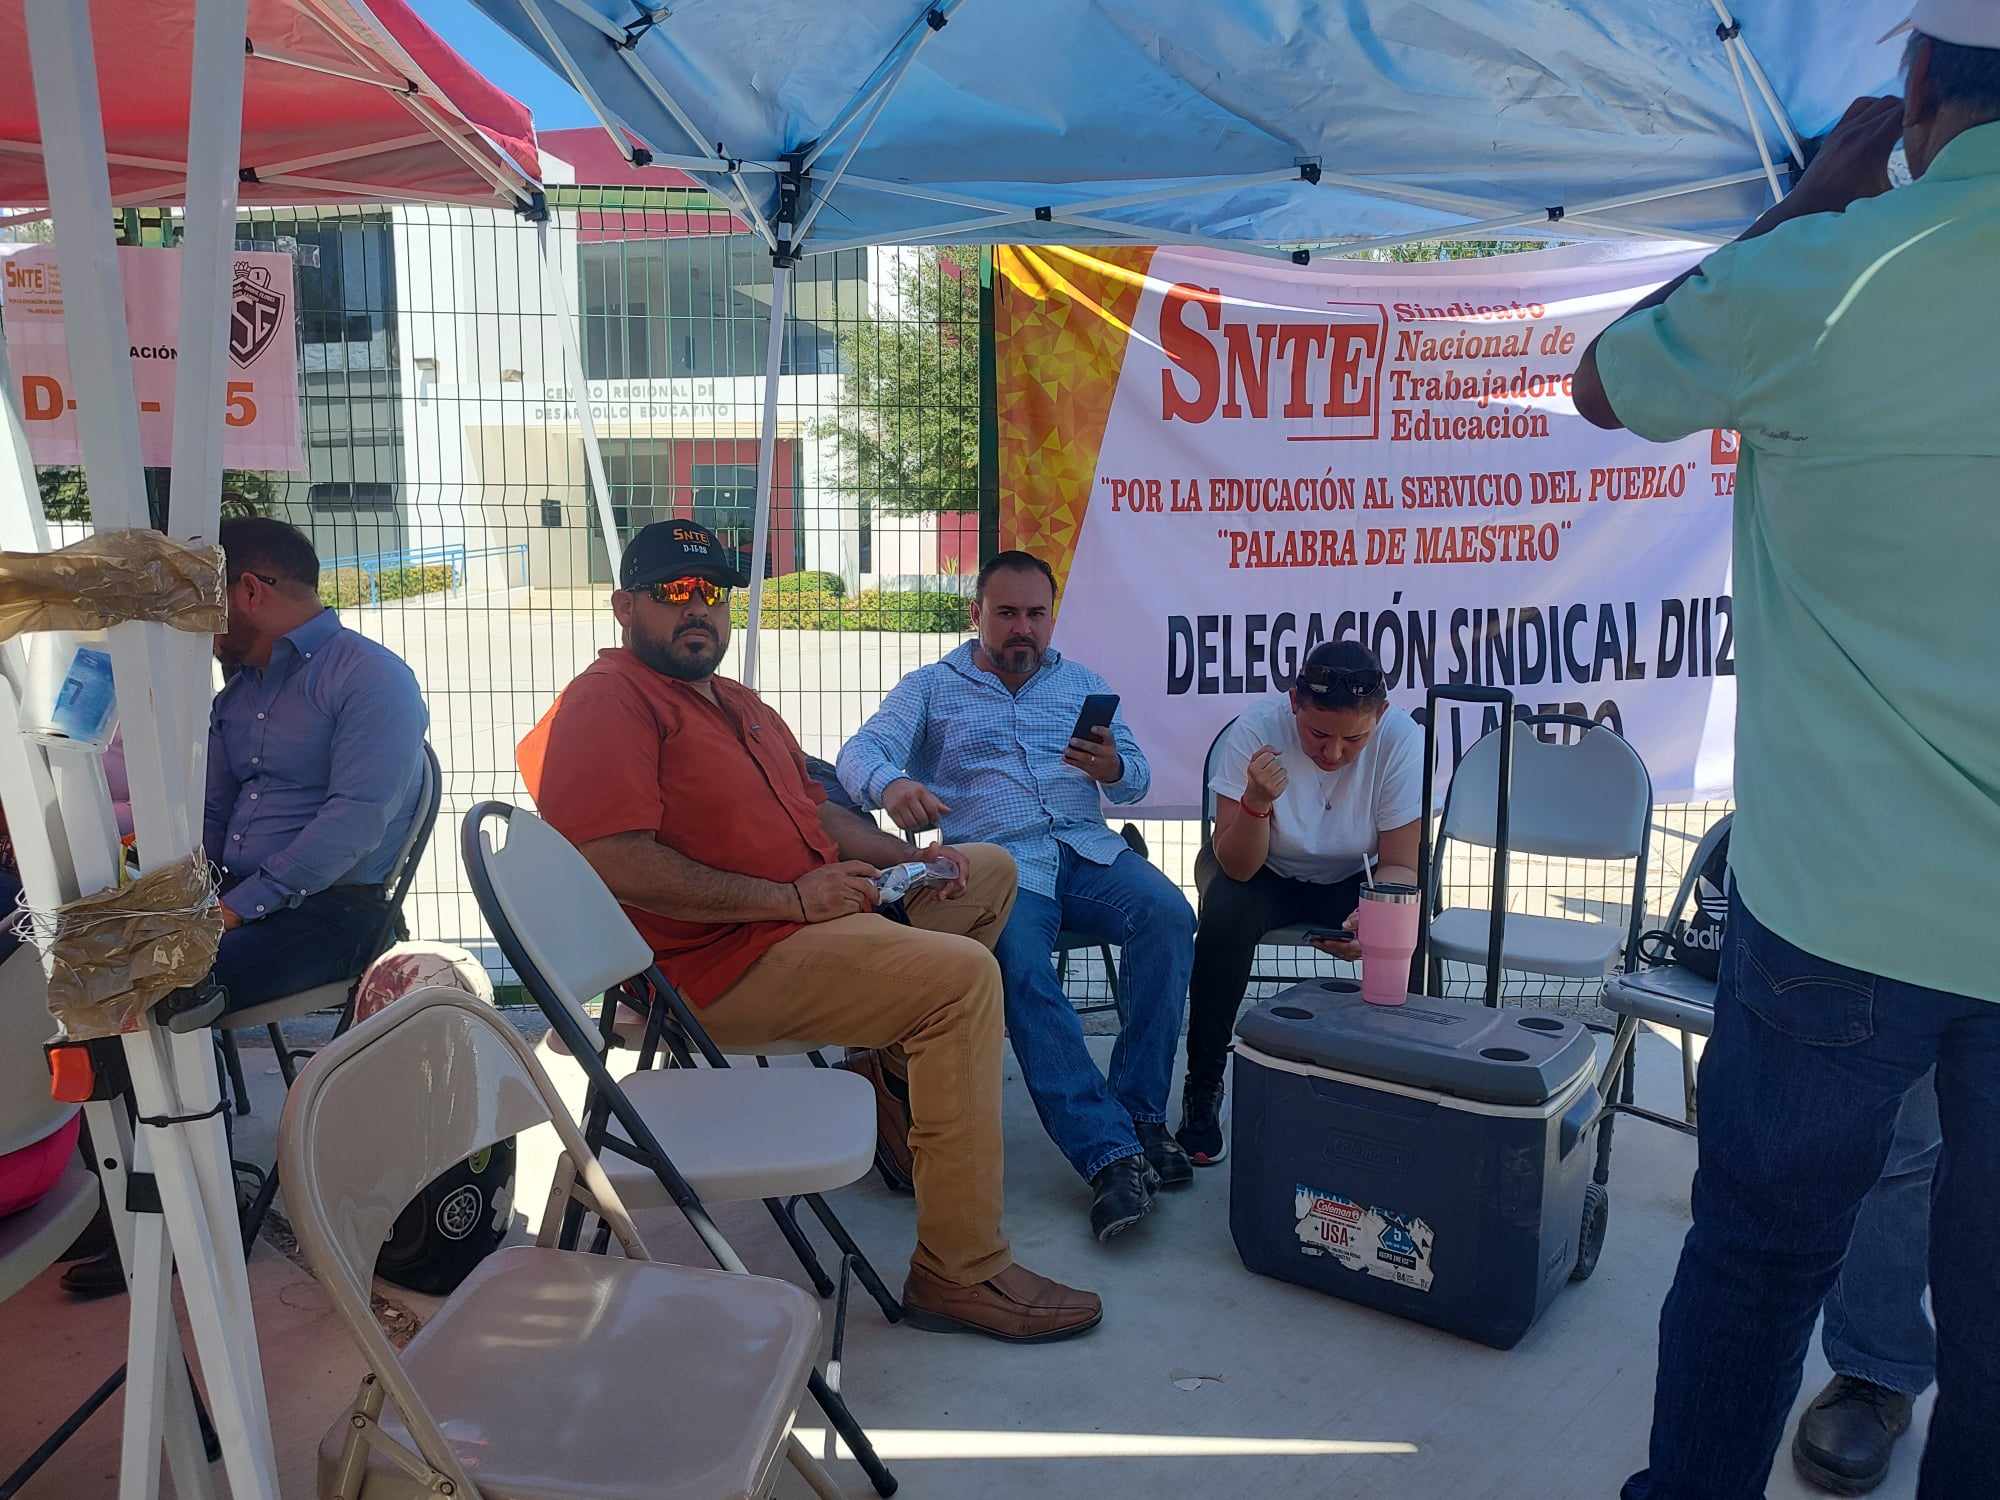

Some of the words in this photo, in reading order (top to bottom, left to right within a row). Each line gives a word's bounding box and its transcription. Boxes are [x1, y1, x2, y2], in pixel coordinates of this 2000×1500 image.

[6, 261, 43, 288] SNTE
[1393, 301, 1546, 323] Sindicato
[1159, 282, 1379, 424] SNTE
[1394, 326, 1533, 362] Nacional
[1541, 325, 1576, 356] de
[546, 386, 603, 399] CENO
[614, 384, 688, 398] REGIONAL
[697, 383, 714, 397] DE
[1390, 367, 1573, 408] Trabajadore
[535, 406, 629, 420] DESAROLLO
[640, 405, 728, 418] EDUCATIVO
[1391, 405, 1550, 441] Educación
[1170, 479, 1203, 512] LA
[1208, 466, 1355, 512] EDUCACIÓN
[1363, 477, 1393, 509] AL
[1402, 472, 1522, 510] SERVICIO
[1529, 470, 1582, 504] DEL
[673, 528, 708, 543] SNTE
[1365, 527, 1407, 565] DE
[1448, 602, 1646, 686] SINDICAL
[1316, 1199, 1352, 1219] Coleman
[1320, 1221, 1349, 1247] USA
